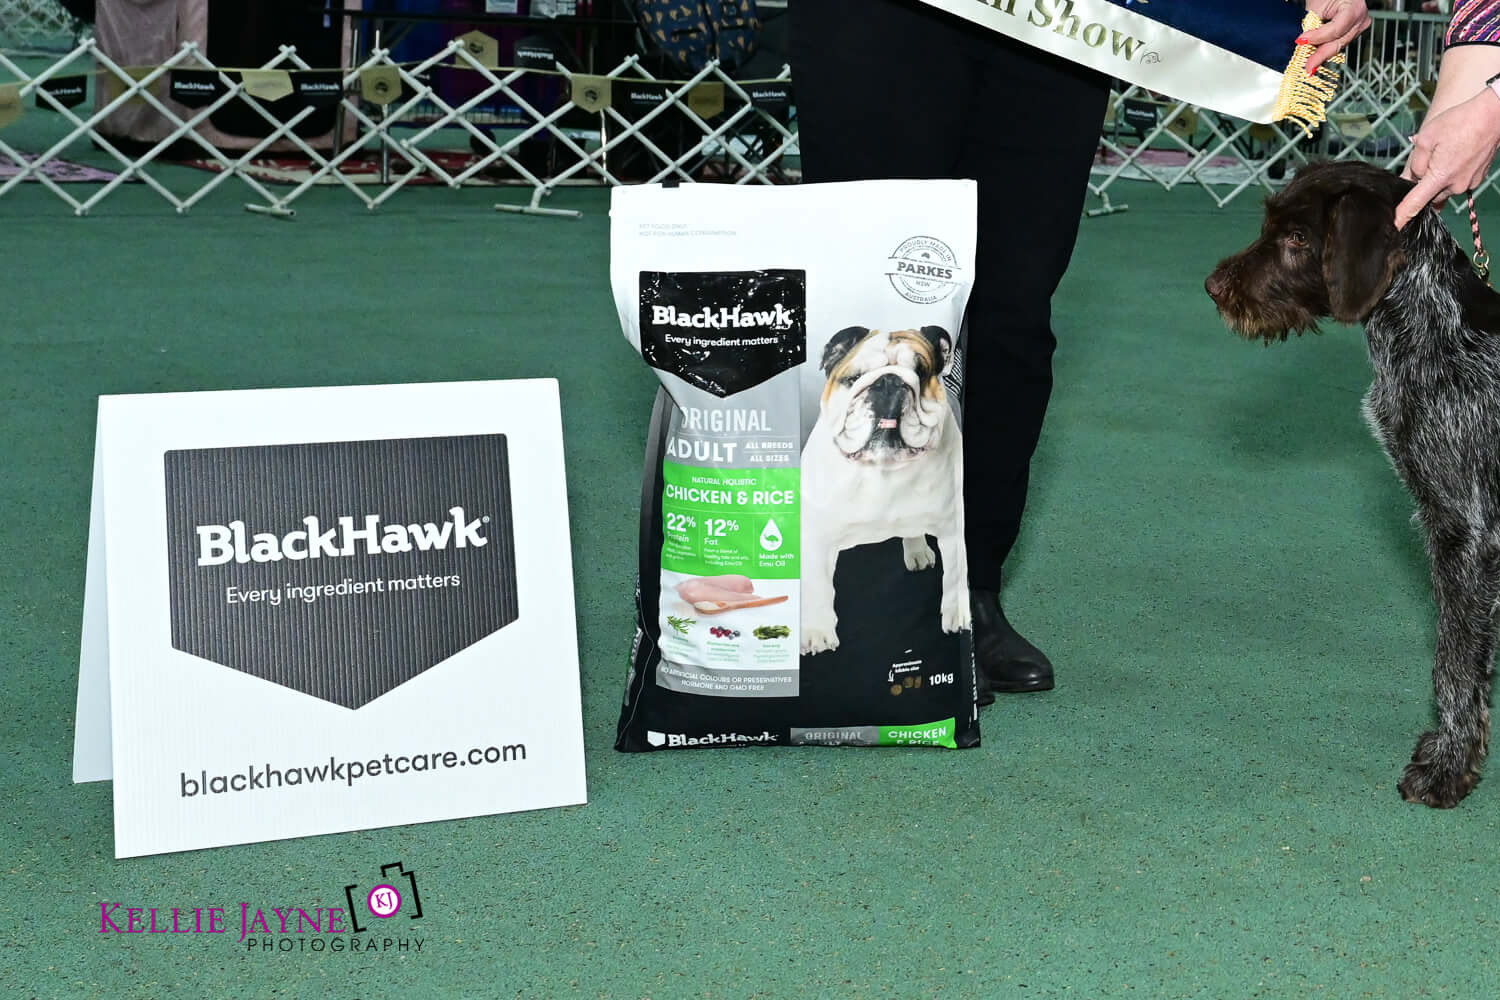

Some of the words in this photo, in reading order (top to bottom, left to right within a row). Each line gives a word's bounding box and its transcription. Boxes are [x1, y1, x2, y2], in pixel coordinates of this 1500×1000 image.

[50, 87, 83, 97] ackHawk
[174, 81, 215, 91] BlackHawk
[301, 83, 340, 91] BlackHawk
[896, 261, 953, 280] PARKES
[915, 280, 932, 288] NSW
[904, 291, 938, 302] AUSTRALIA
[651, 303, 794, 328] BlackHawk
[664, 333, 691, 347] Every
[692, 336, 741, 348] ingredient
[741, 335, 779, 346] matters
[666, 437, 737, 463] ADULT
[745, 441, 759, 449] ALL
[761, 441, 793, 449] BREEDS
[766, 454, 790, 462] SIZES
[691, 476, 721, 485] NATURAL
[666, 484, 732, 504] CHICKEN
[736, 491, 748, 505] &
[752, 490, 794, 504] RICE
[666, 512, 697, 532] 22%
[704, 518, 739, 537] 12%
[196, 506, 488, 566] BlackHawk
[704, 537, 718, 546] Fat
[759, 552, 778, 560] Made
[779, 552, 795, 560] with
[759, 560, 774, 568] Emu
[226, 585, 281, 606] Every
[286, 578, 384, 603] ingredient
[388, 574, 460, 593] matters
[681, 679, 713, 690] HORMONE
[700, 674, 731, 683] COLOURS
[929, 672, 954, 686] 10kg
[668, 731, 777, 747] BlackHawk
[805, 731, 864, 740] ORIGINAL
[888, 726, 947, 739] CHICKEN
[180, 743, 527, 797] blackhawkpetcare.com
